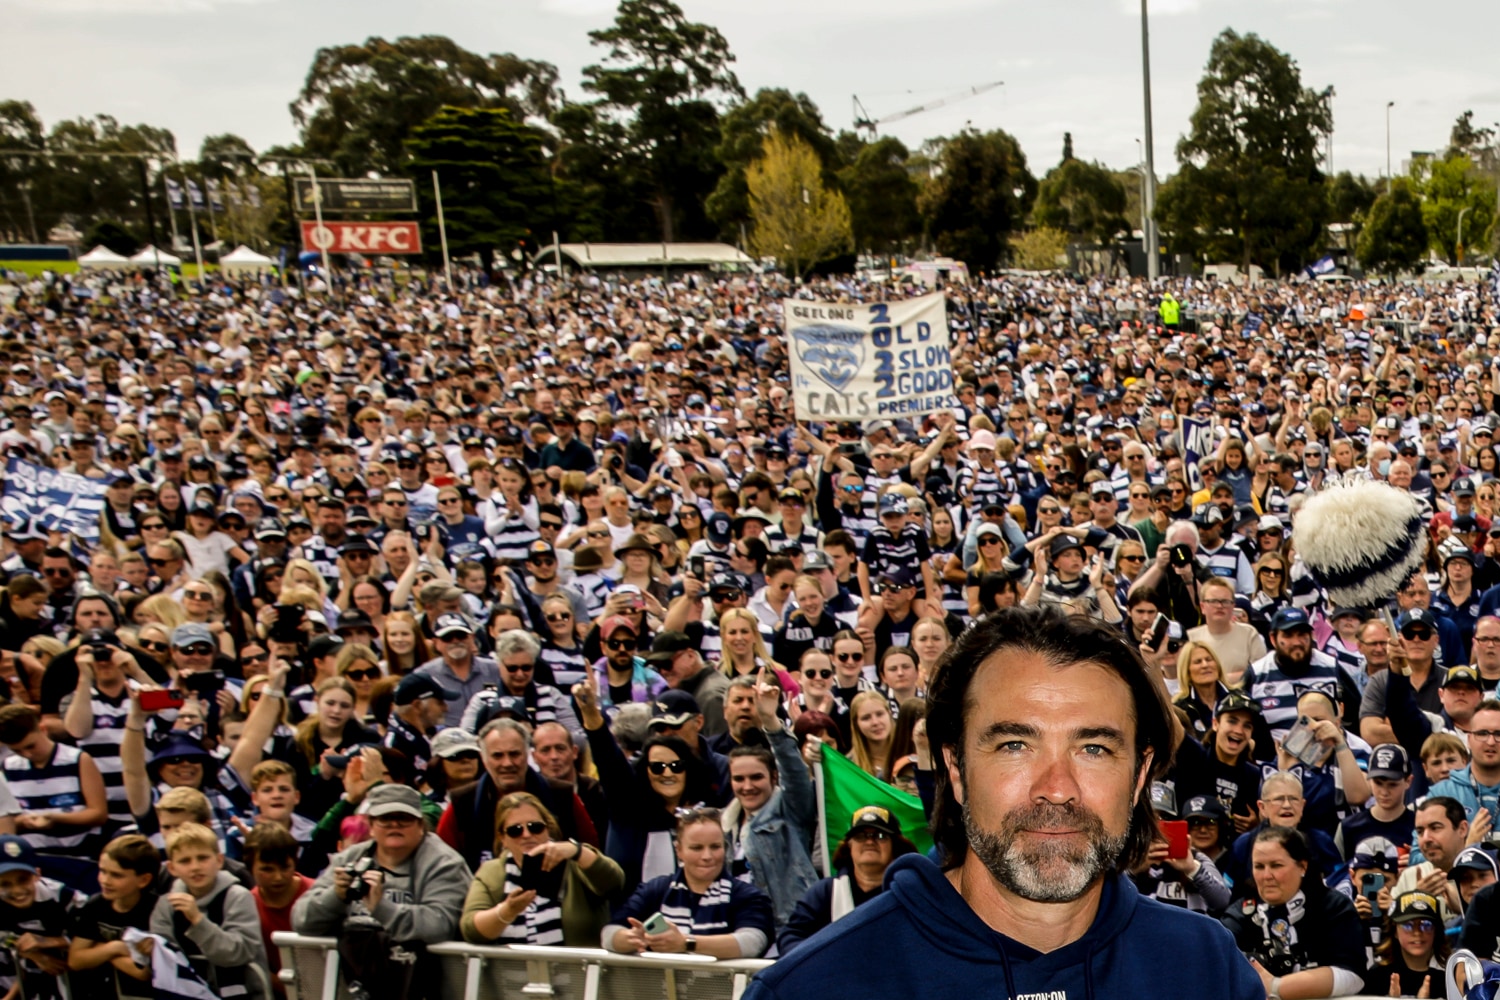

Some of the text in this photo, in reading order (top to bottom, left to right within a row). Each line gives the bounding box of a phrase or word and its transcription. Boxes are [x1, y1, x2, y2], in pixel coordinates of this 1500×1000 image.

[340, 226, 410, 249] KFC
[793, 306, 854, 320] GEELONG
[869, 303, 891, 324] 2
[874, 345, 951, 373] 2 SLOW
[874, 369, 952, 398] 2 GOOD
[808, 391, 870, 416] CATS
[878, 394, 955, 414] PREMIERS
